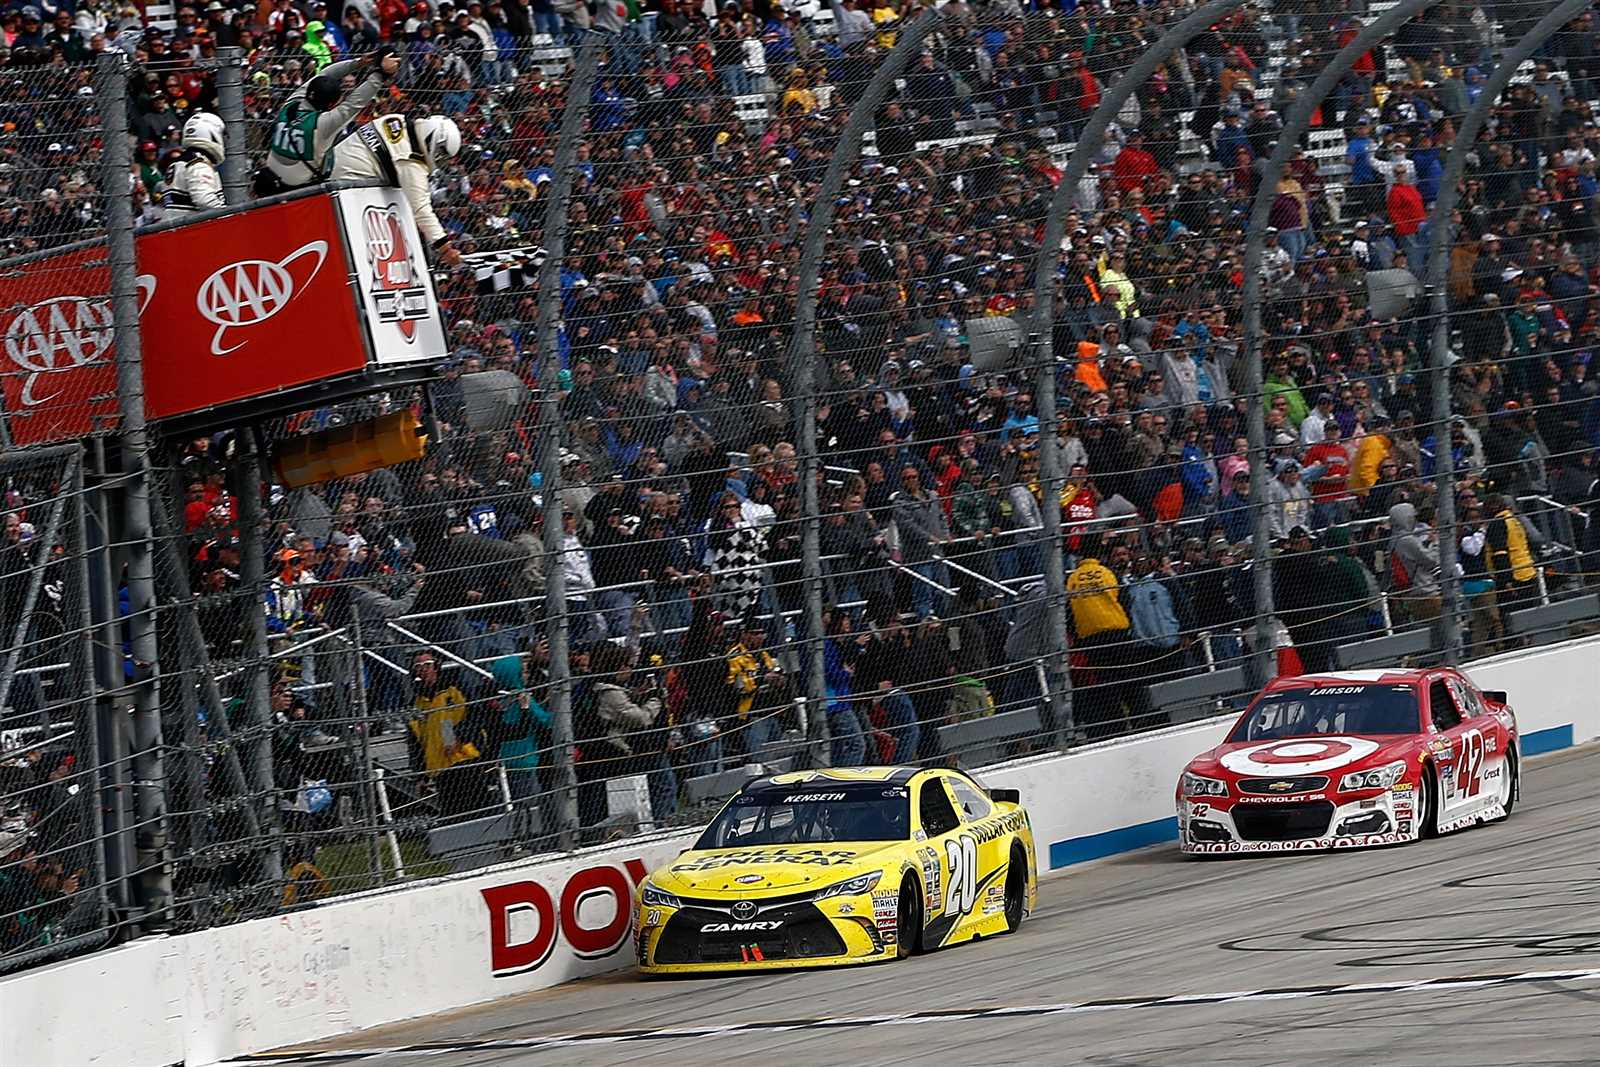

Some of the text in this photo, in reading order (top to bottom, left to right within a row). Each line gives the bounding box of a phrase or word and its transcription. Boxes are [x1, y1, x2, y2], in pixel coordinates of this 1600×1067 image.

[205, 262, 287, 325] AAA
[20, 299, 112, 370] AAA
[1309, 686, 1365, 696] LARSON
[1456, 728, 1484, 799] 42
[1483, 767, 1501, 780] Crest
[783, 792, 847, 803] KENSETH
[1192, 804, 1208, 818] 42
[671, 856, 854, 872] GENERAL
[694, 849, 857, 864] DOLLAR
[944, 834, 978, 918] 20
[646, 910, 661, 925] 20
[700, 920, 785, 933] CAMRY
